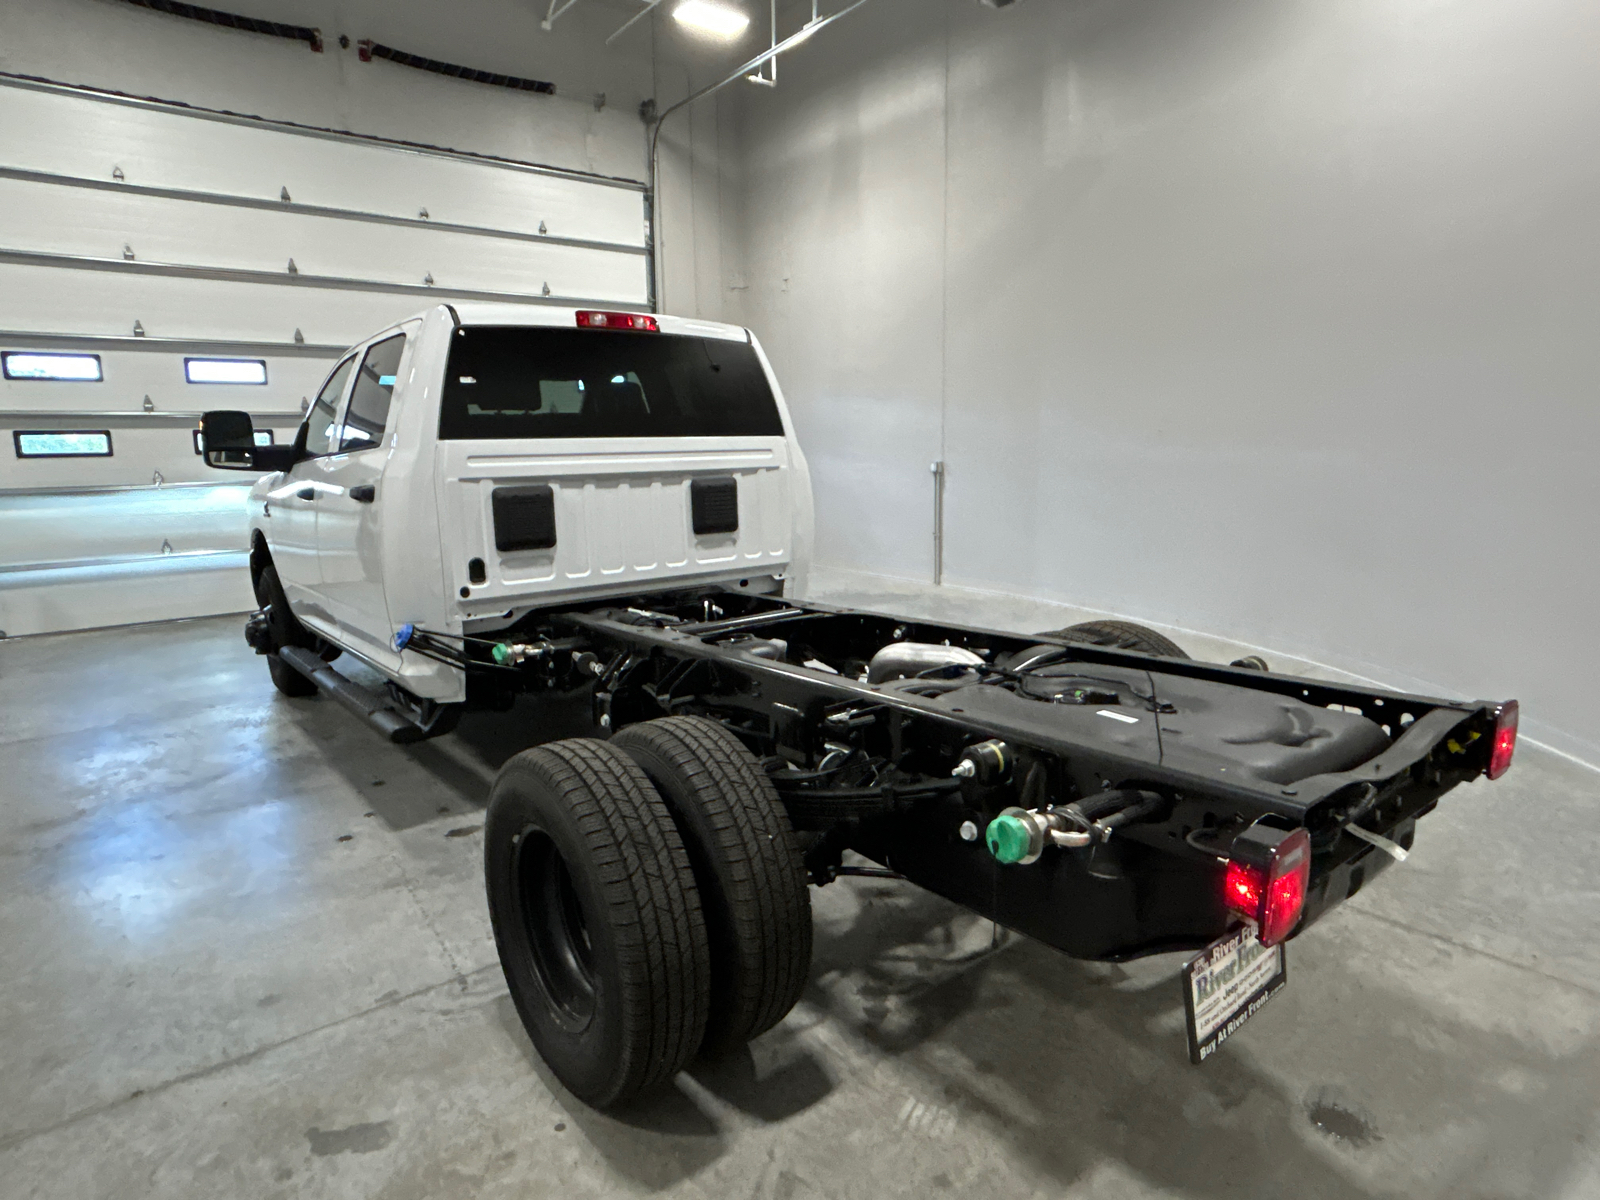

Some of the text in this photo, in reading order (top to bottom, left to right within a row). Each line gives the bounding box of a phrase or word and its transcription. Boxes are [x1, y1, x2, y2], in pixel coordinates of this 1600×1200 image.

[1213, 935, 1239, 962] River
[1195, 959, 1236, 1006] River
[1223, 983, 1238, 1000] Jeep
[1200, 1039, 1216, 1060] Buy
[1218, 1028, 1227, 1044] At
[1227, 1011, 1247, 1035] River
